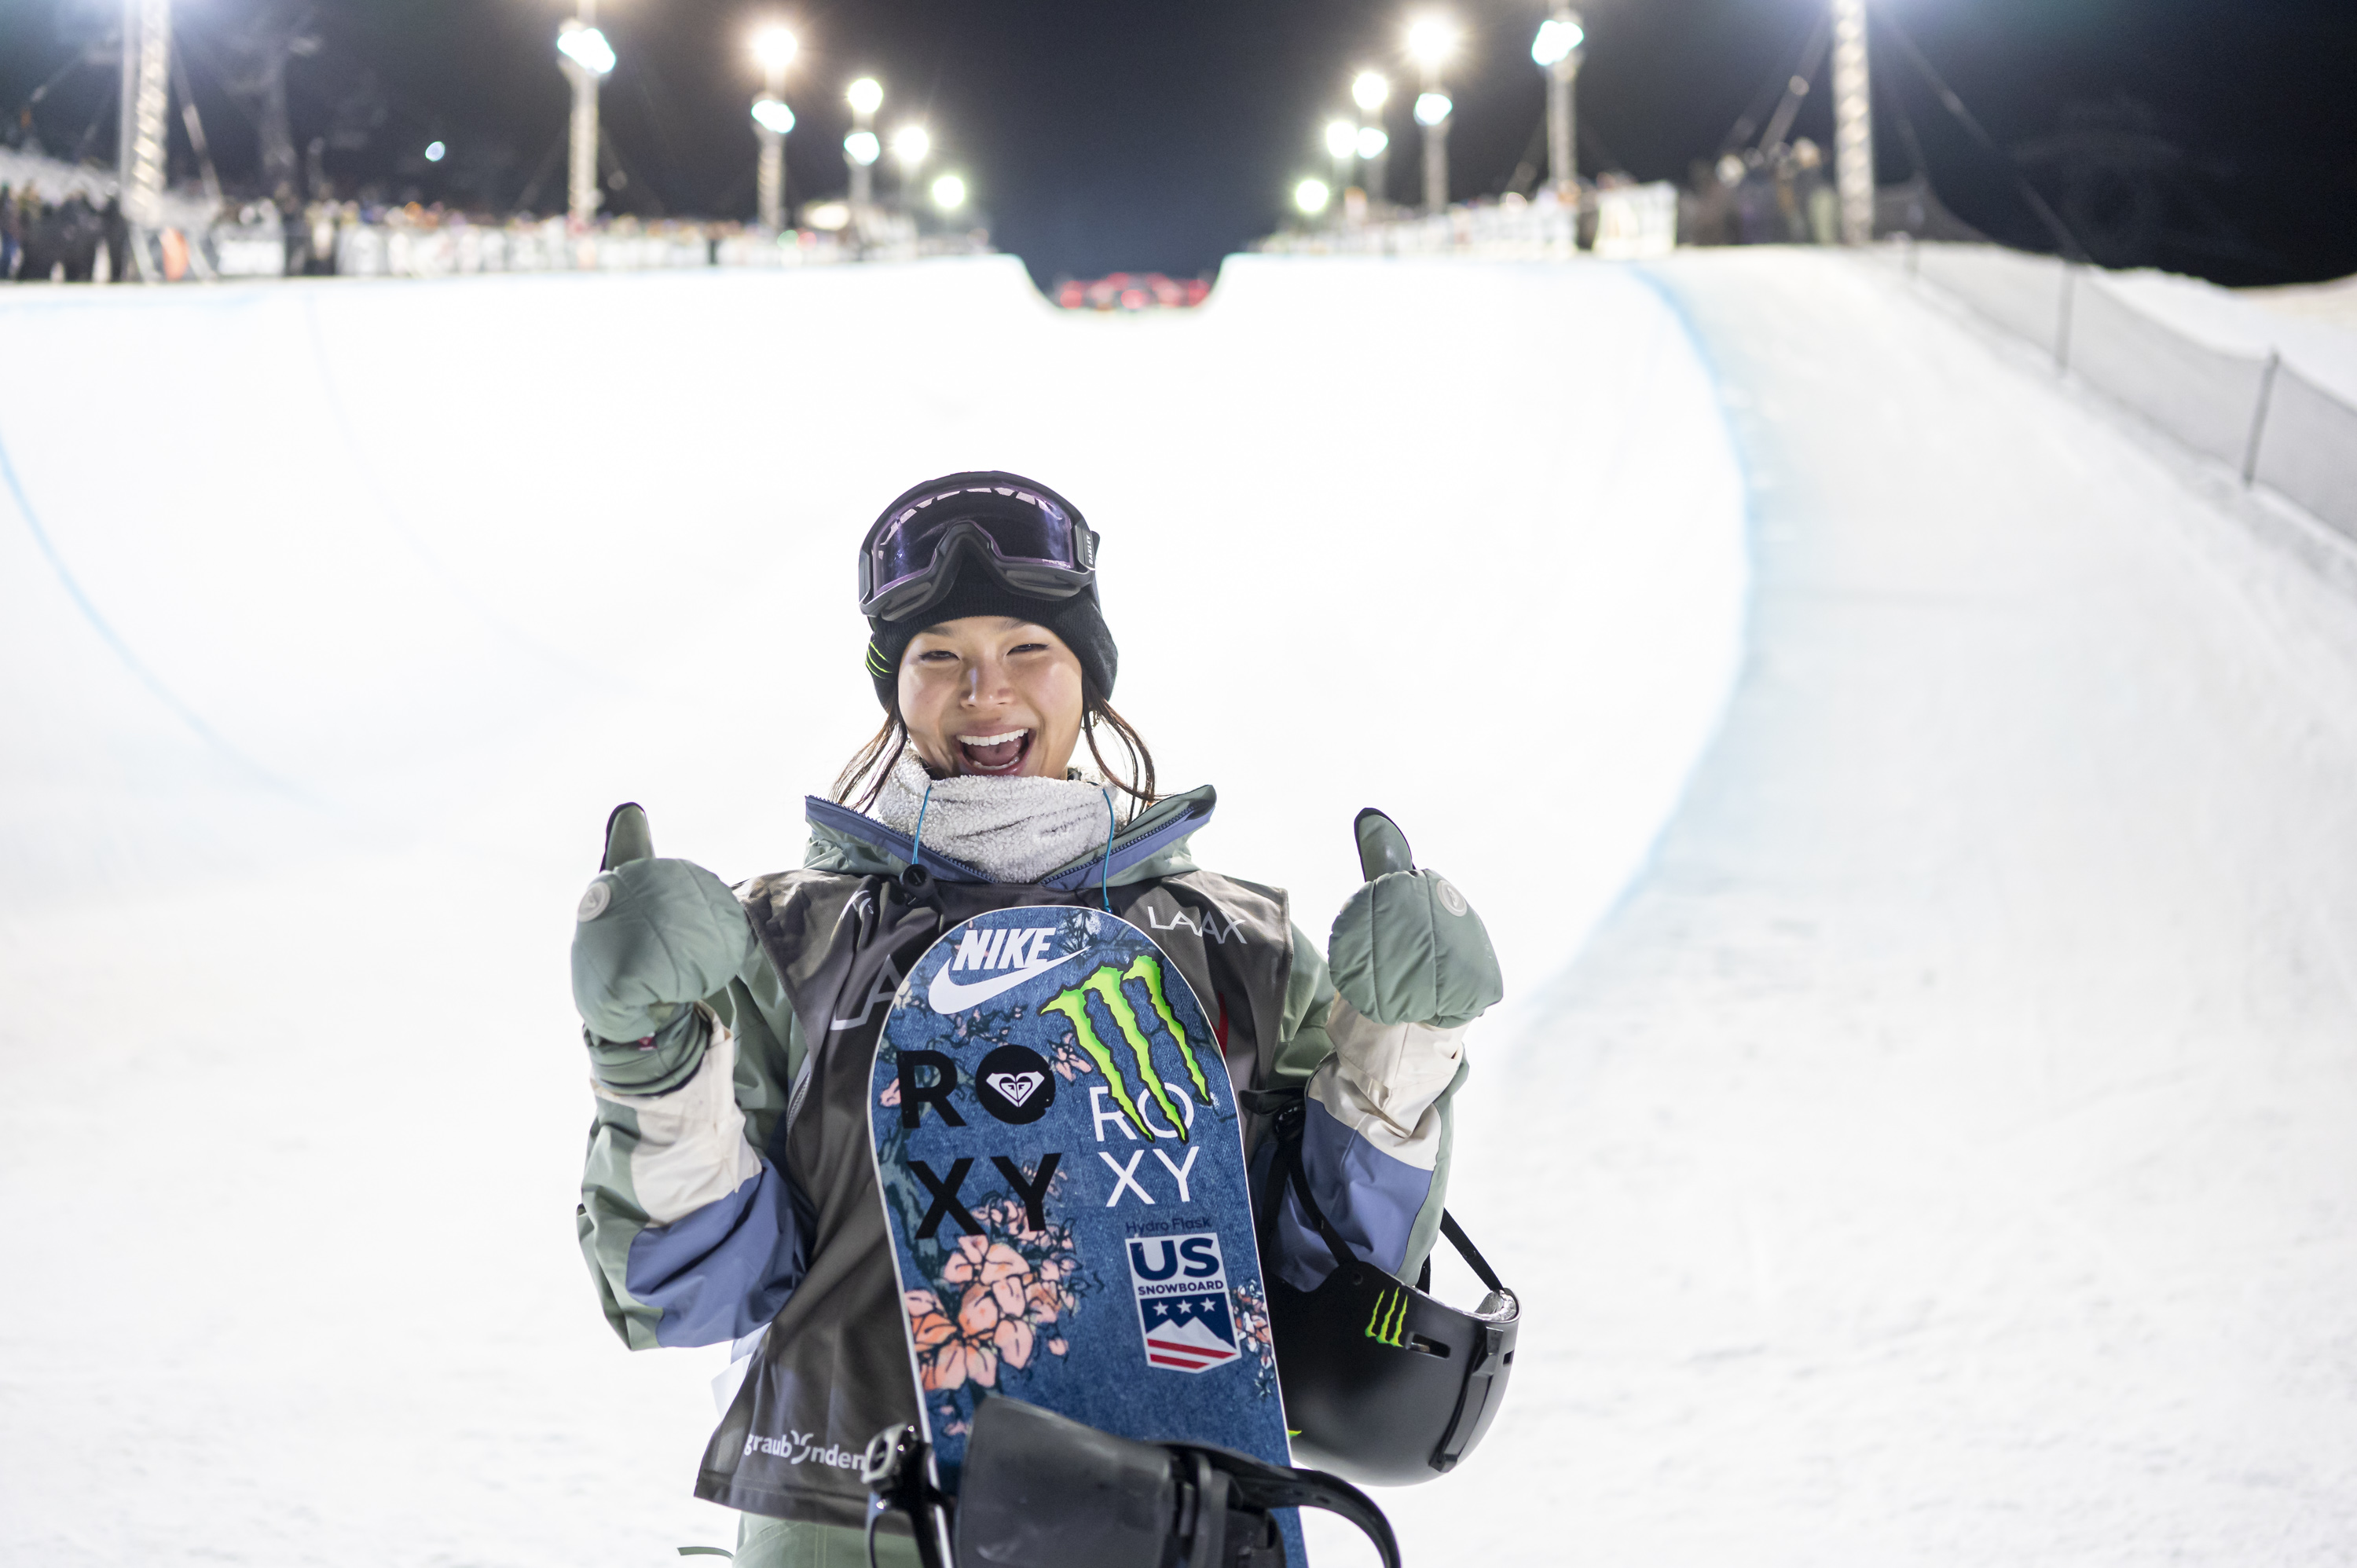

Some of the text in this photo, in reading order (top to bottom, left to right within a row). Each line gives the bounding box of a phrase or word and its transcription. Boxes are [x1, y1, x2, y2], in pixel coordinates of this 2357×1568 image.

[1147, 906, 1248, 944] LAAX
[951, 928, 1057, 971] NIKE
[907, 1152, 1062, 1240] XY
[1098, 1146, 1200, 1207] XY
[1125, 1216, 1212, 1235] Hydro Flask
[1129, 1237, 1220, 1281] US
[1138, 1280, 1224, 1296] SNOWBOARD
